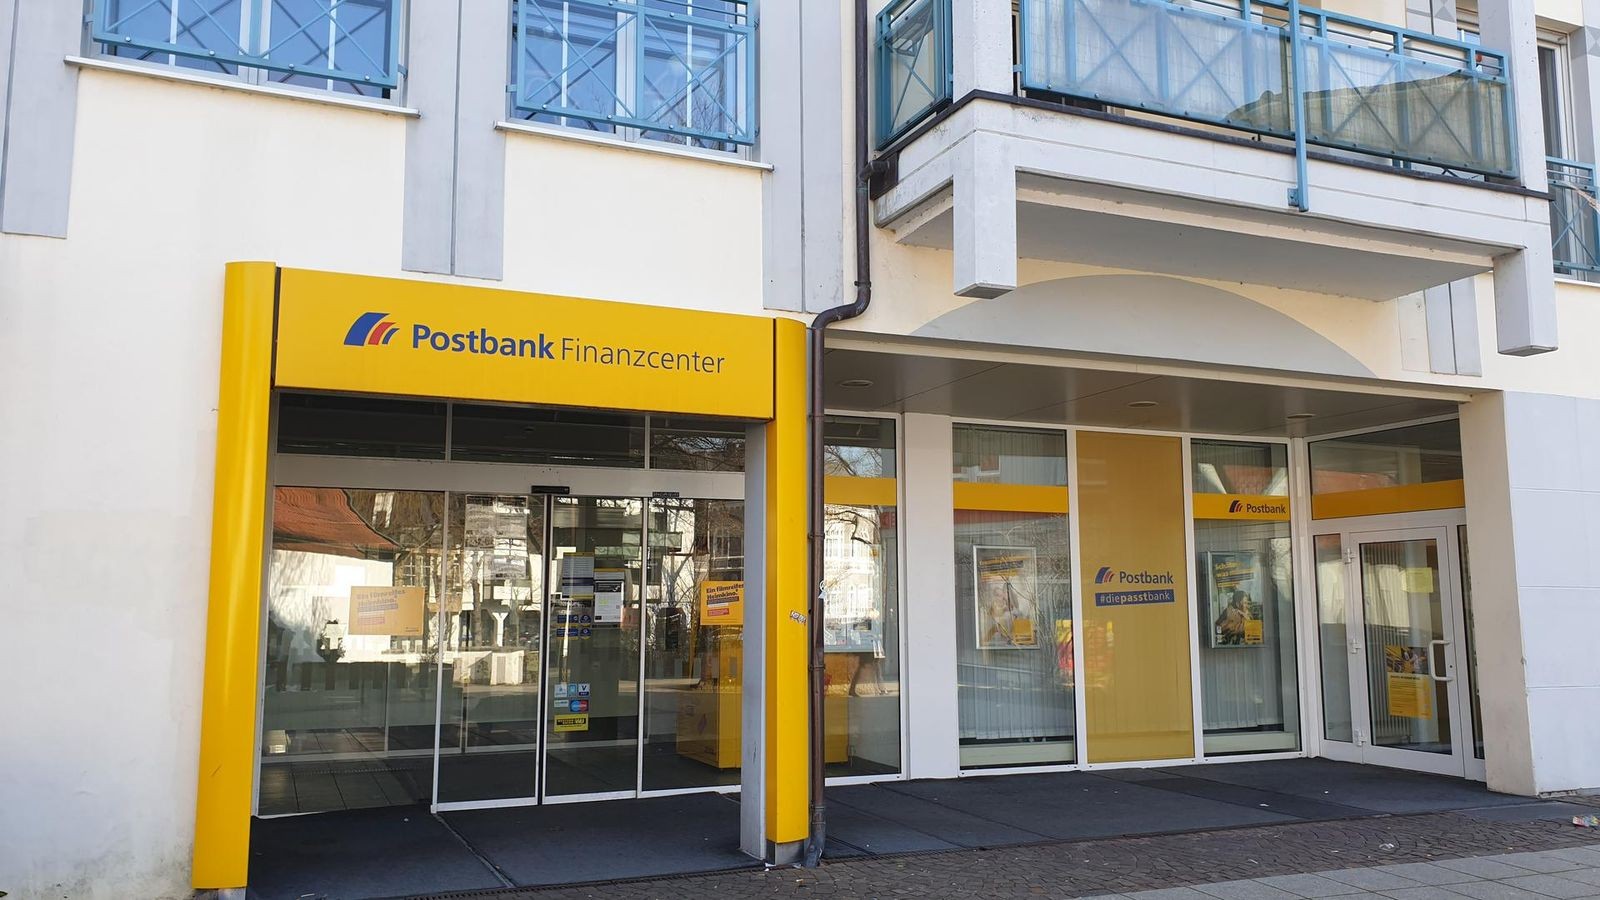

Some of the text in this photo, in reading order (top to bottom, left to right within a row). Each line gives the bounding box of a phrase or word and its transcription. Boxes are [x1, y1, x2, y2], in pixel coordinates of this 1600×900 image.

[412, 323, 726, 374] Postbank Finanzcenter
[1246, 503, 1286, 514] Postbank
[1119, 570, 1174, 585] Postbank
[1100, 590, 1171, 605] #diepasstbank
